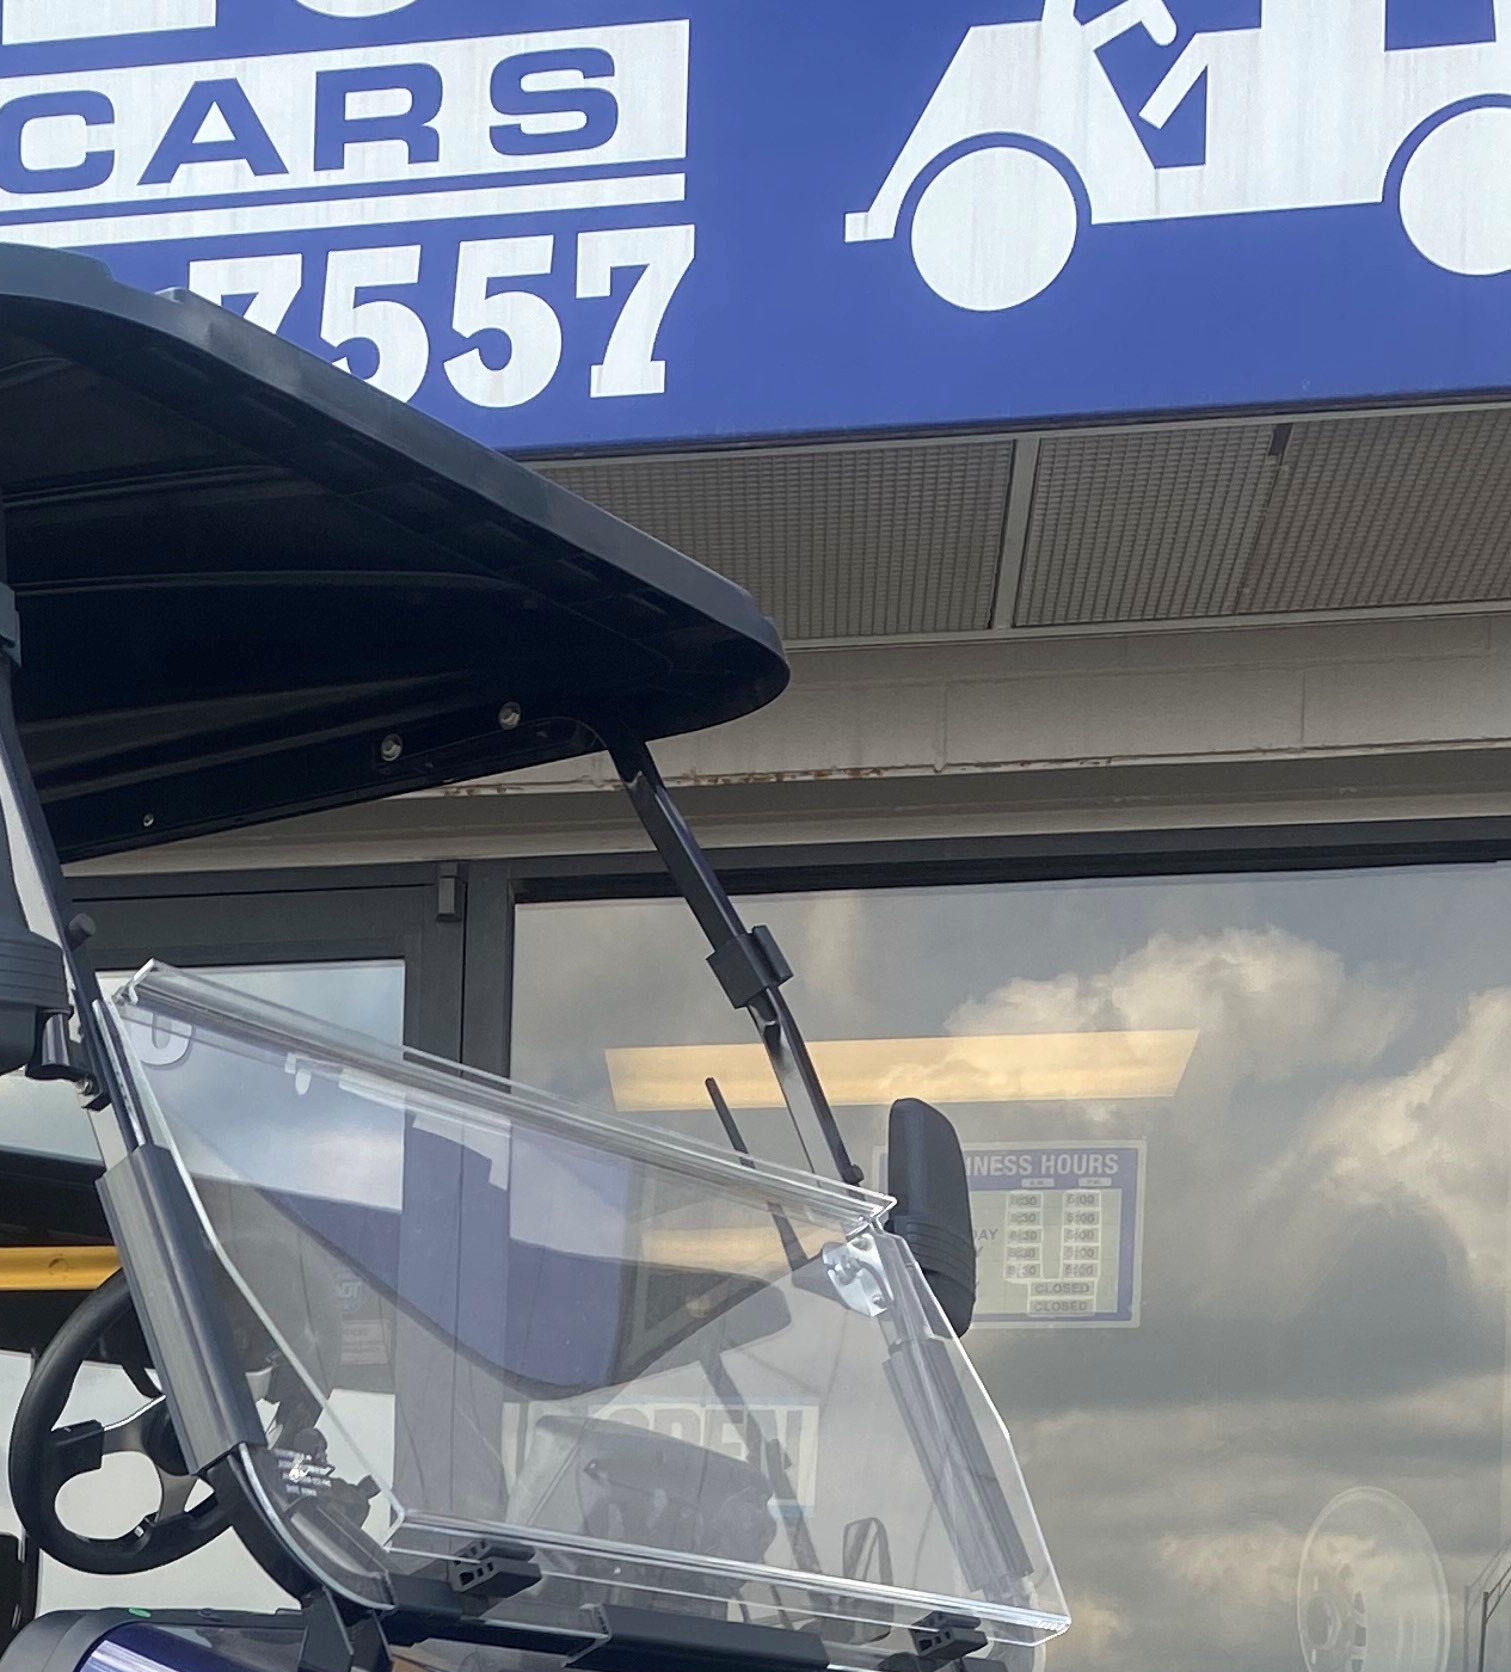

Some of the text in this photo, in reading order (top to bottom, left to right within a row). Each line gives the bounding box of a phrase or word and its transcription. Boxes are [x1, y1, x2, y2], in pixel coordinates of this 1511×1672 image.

[966, 1153, 1120, 1176] INESS HOURS
[1034, 1282, 1090, 1295] CLOSED
[1033, 1301, 1088, 1313] CLOSED
